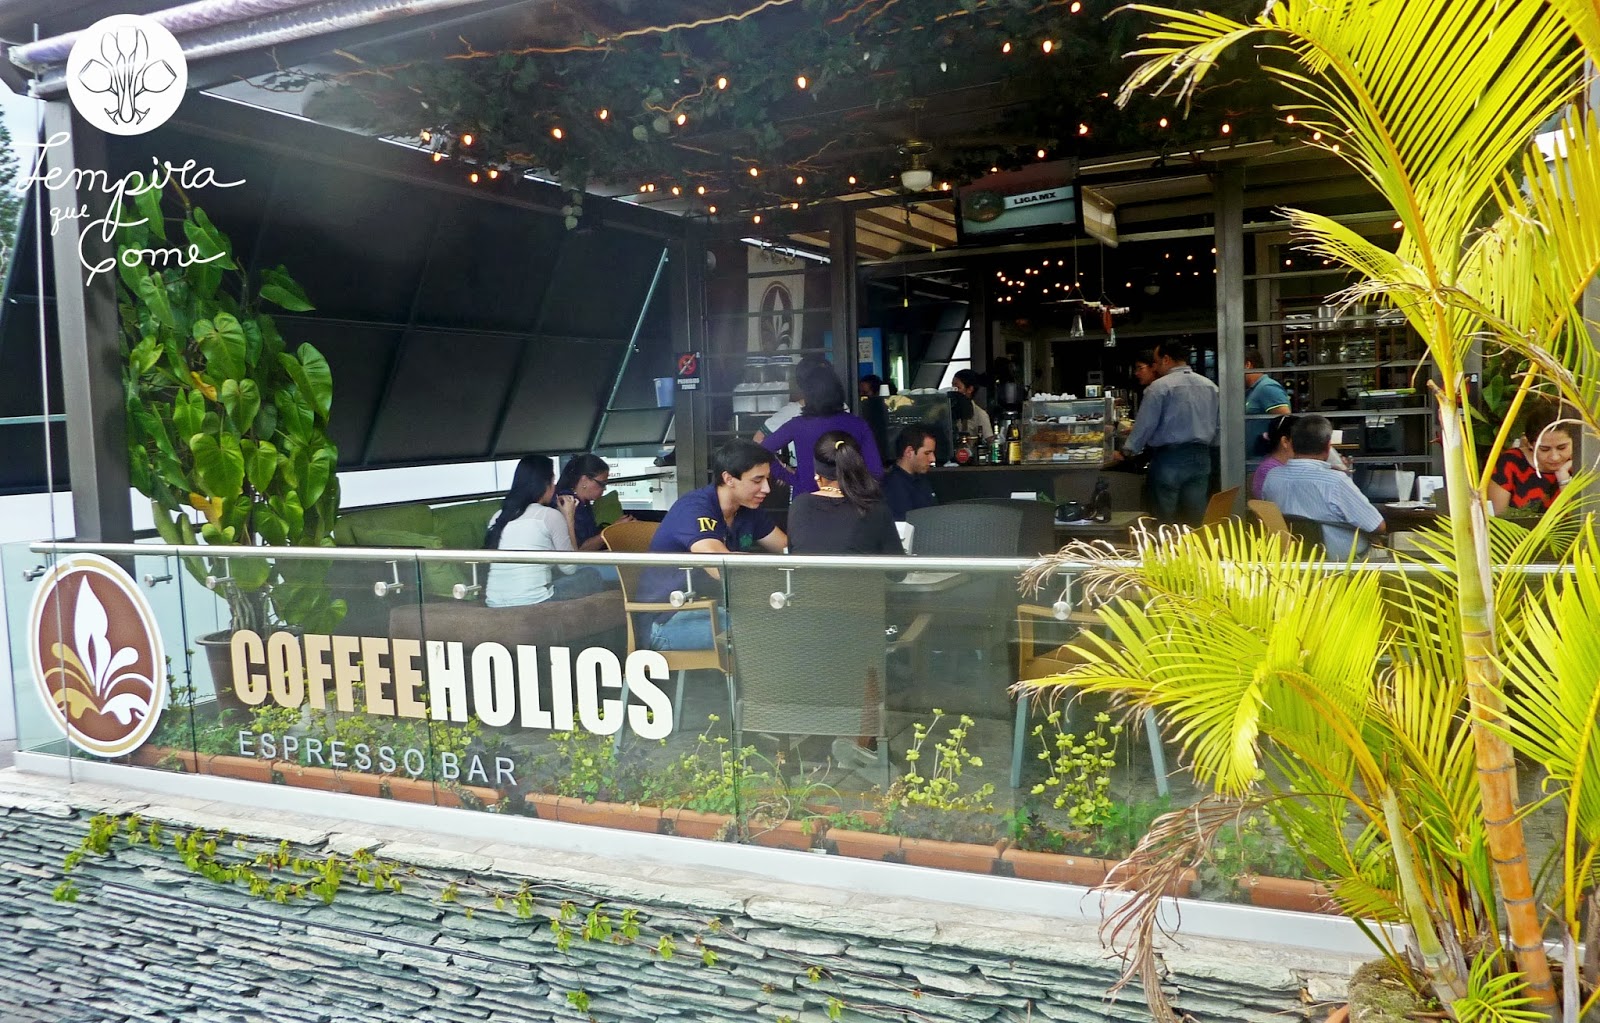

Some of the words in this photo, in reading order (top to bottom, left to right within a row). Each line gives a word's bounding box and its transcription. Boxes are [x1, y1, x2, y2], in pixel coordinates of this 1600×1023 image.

[1014, 195, 1038, 204] LIGA
[1039, 192, 1056, 200] MX
[697, 517, 718, 532] IV
[230, 629, 675, 740] COFFEEHOLICS
[238, 730, 426, 777] ESPRESSO
[442, 752, 518, 786] BAR
